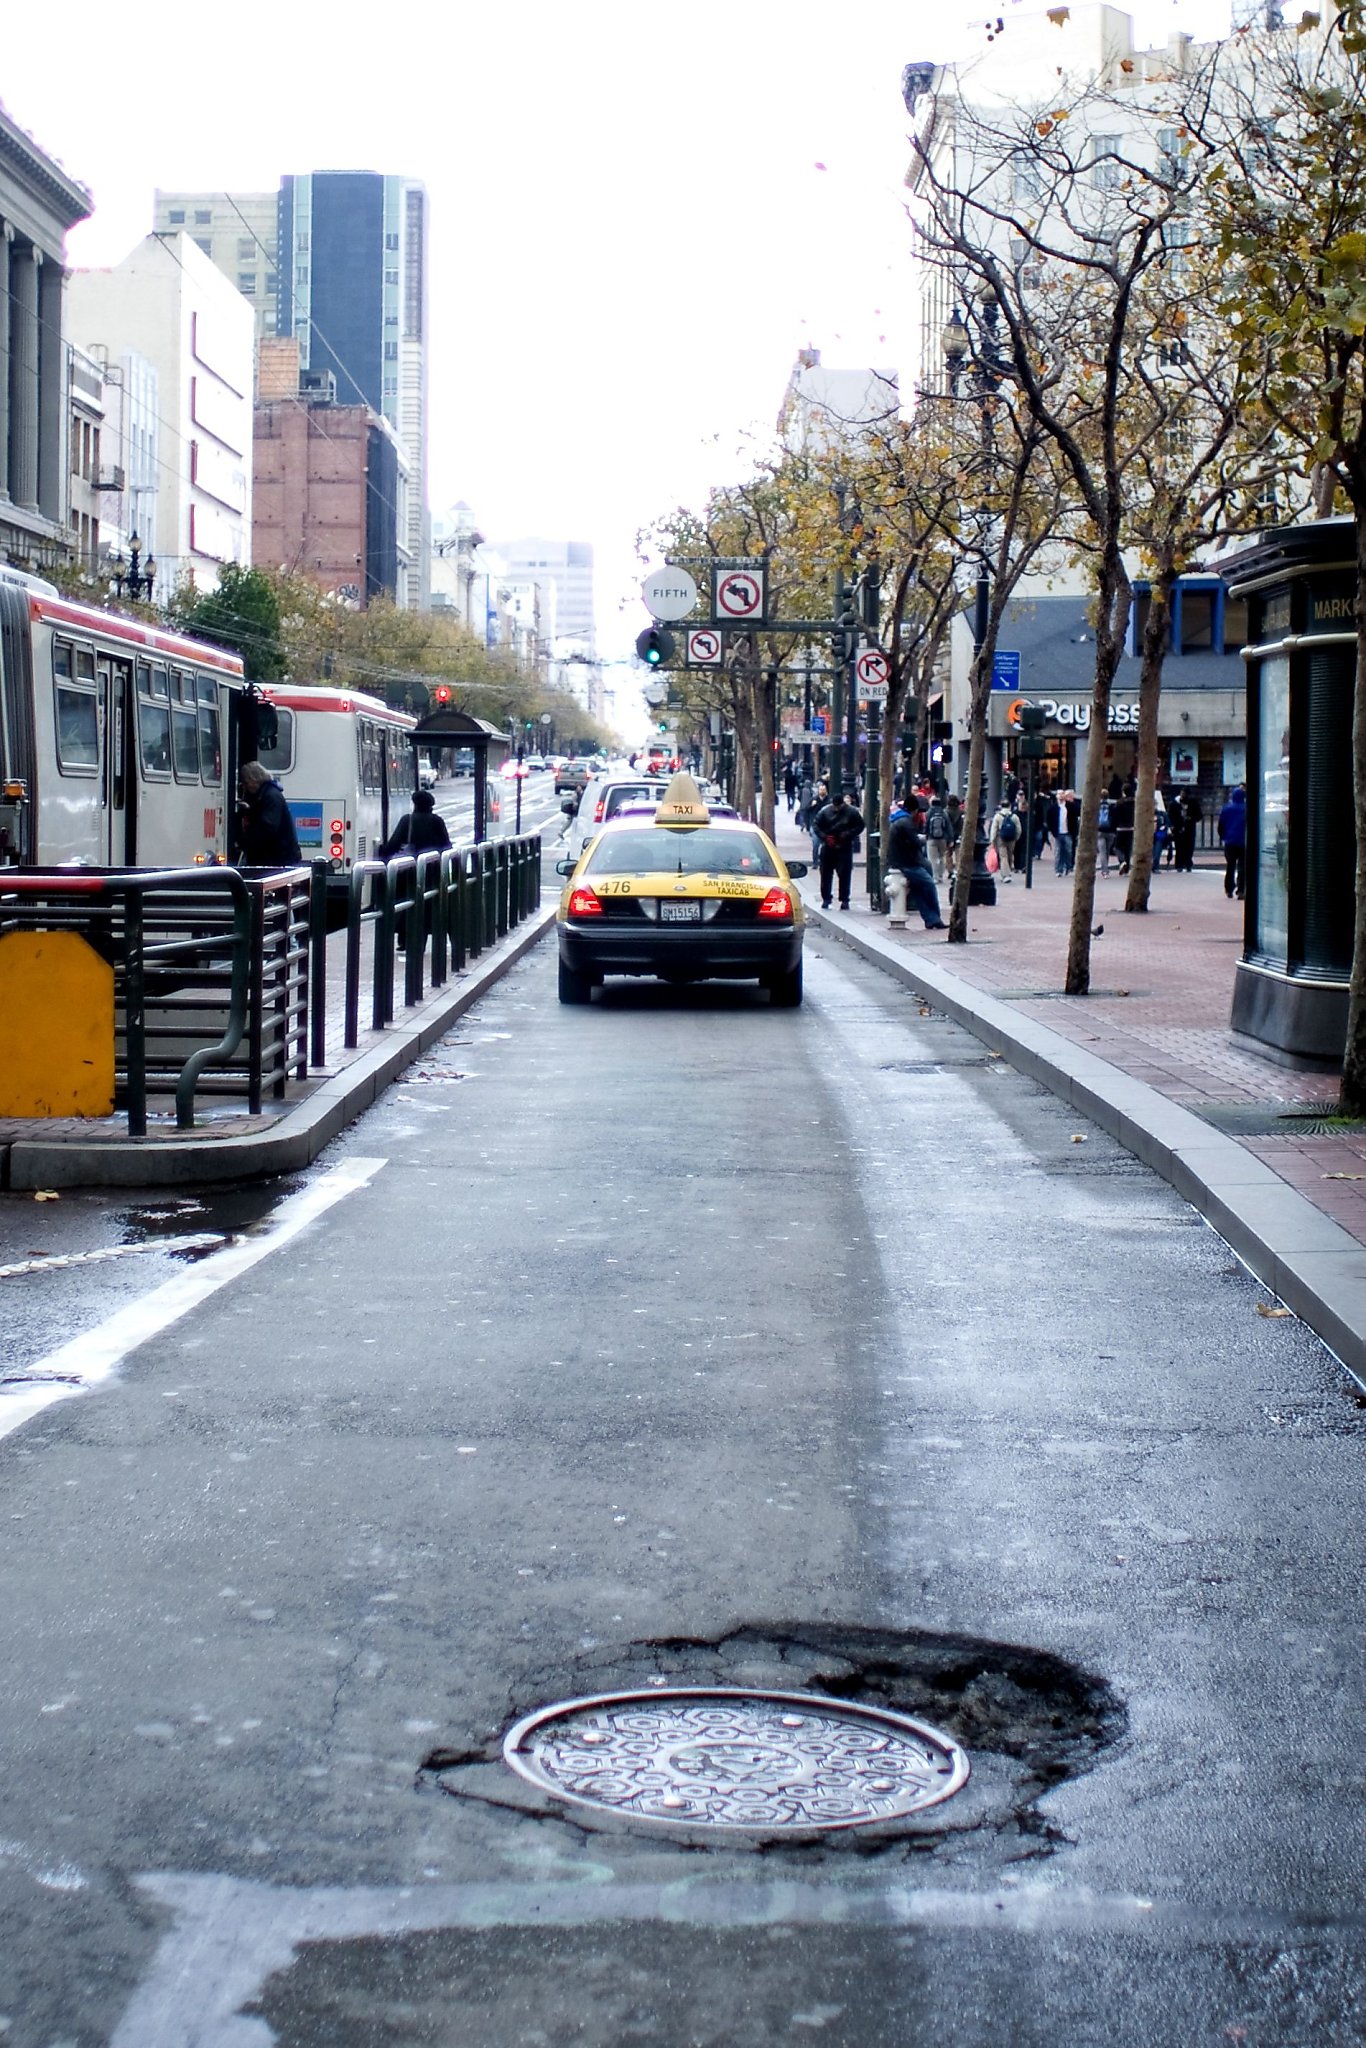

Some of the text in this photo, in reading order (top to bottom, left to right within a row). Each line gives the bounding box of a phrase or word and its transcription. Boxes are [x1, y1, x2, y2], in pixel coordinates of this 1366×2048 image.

[652, 588, 688, 598] FIFTH
[1314, 598, 1352, 619] MARK
[860, 686, 888, 696] ON RED
[672, 805, 693, 815] TAXI
[599, 880, 631, 894] 476
[722, 880, 765, 891] FRANCISCO
[717, 887, 750, 896] TAXICAB
